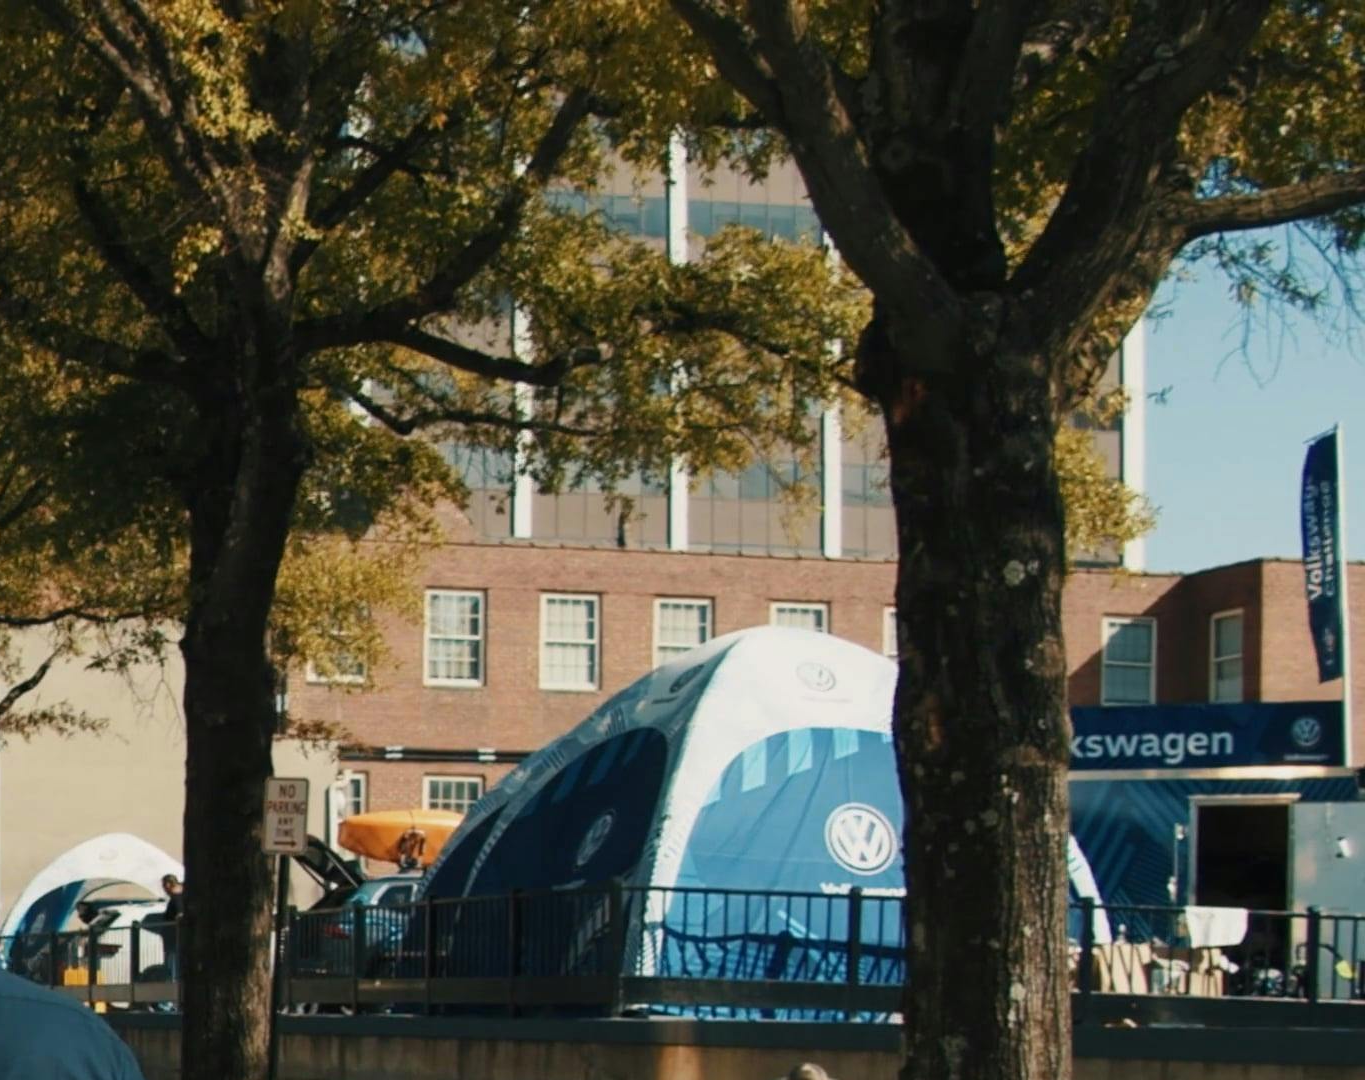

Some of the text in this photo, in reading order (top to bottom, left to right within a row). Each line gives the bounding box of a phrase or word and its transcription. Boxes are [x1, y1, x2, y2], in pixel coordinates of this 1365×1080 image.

[279, 784, 296, 799] NO
[267, 801, 306, 815] PARKING
[278, 817, 294, 825] ANY
